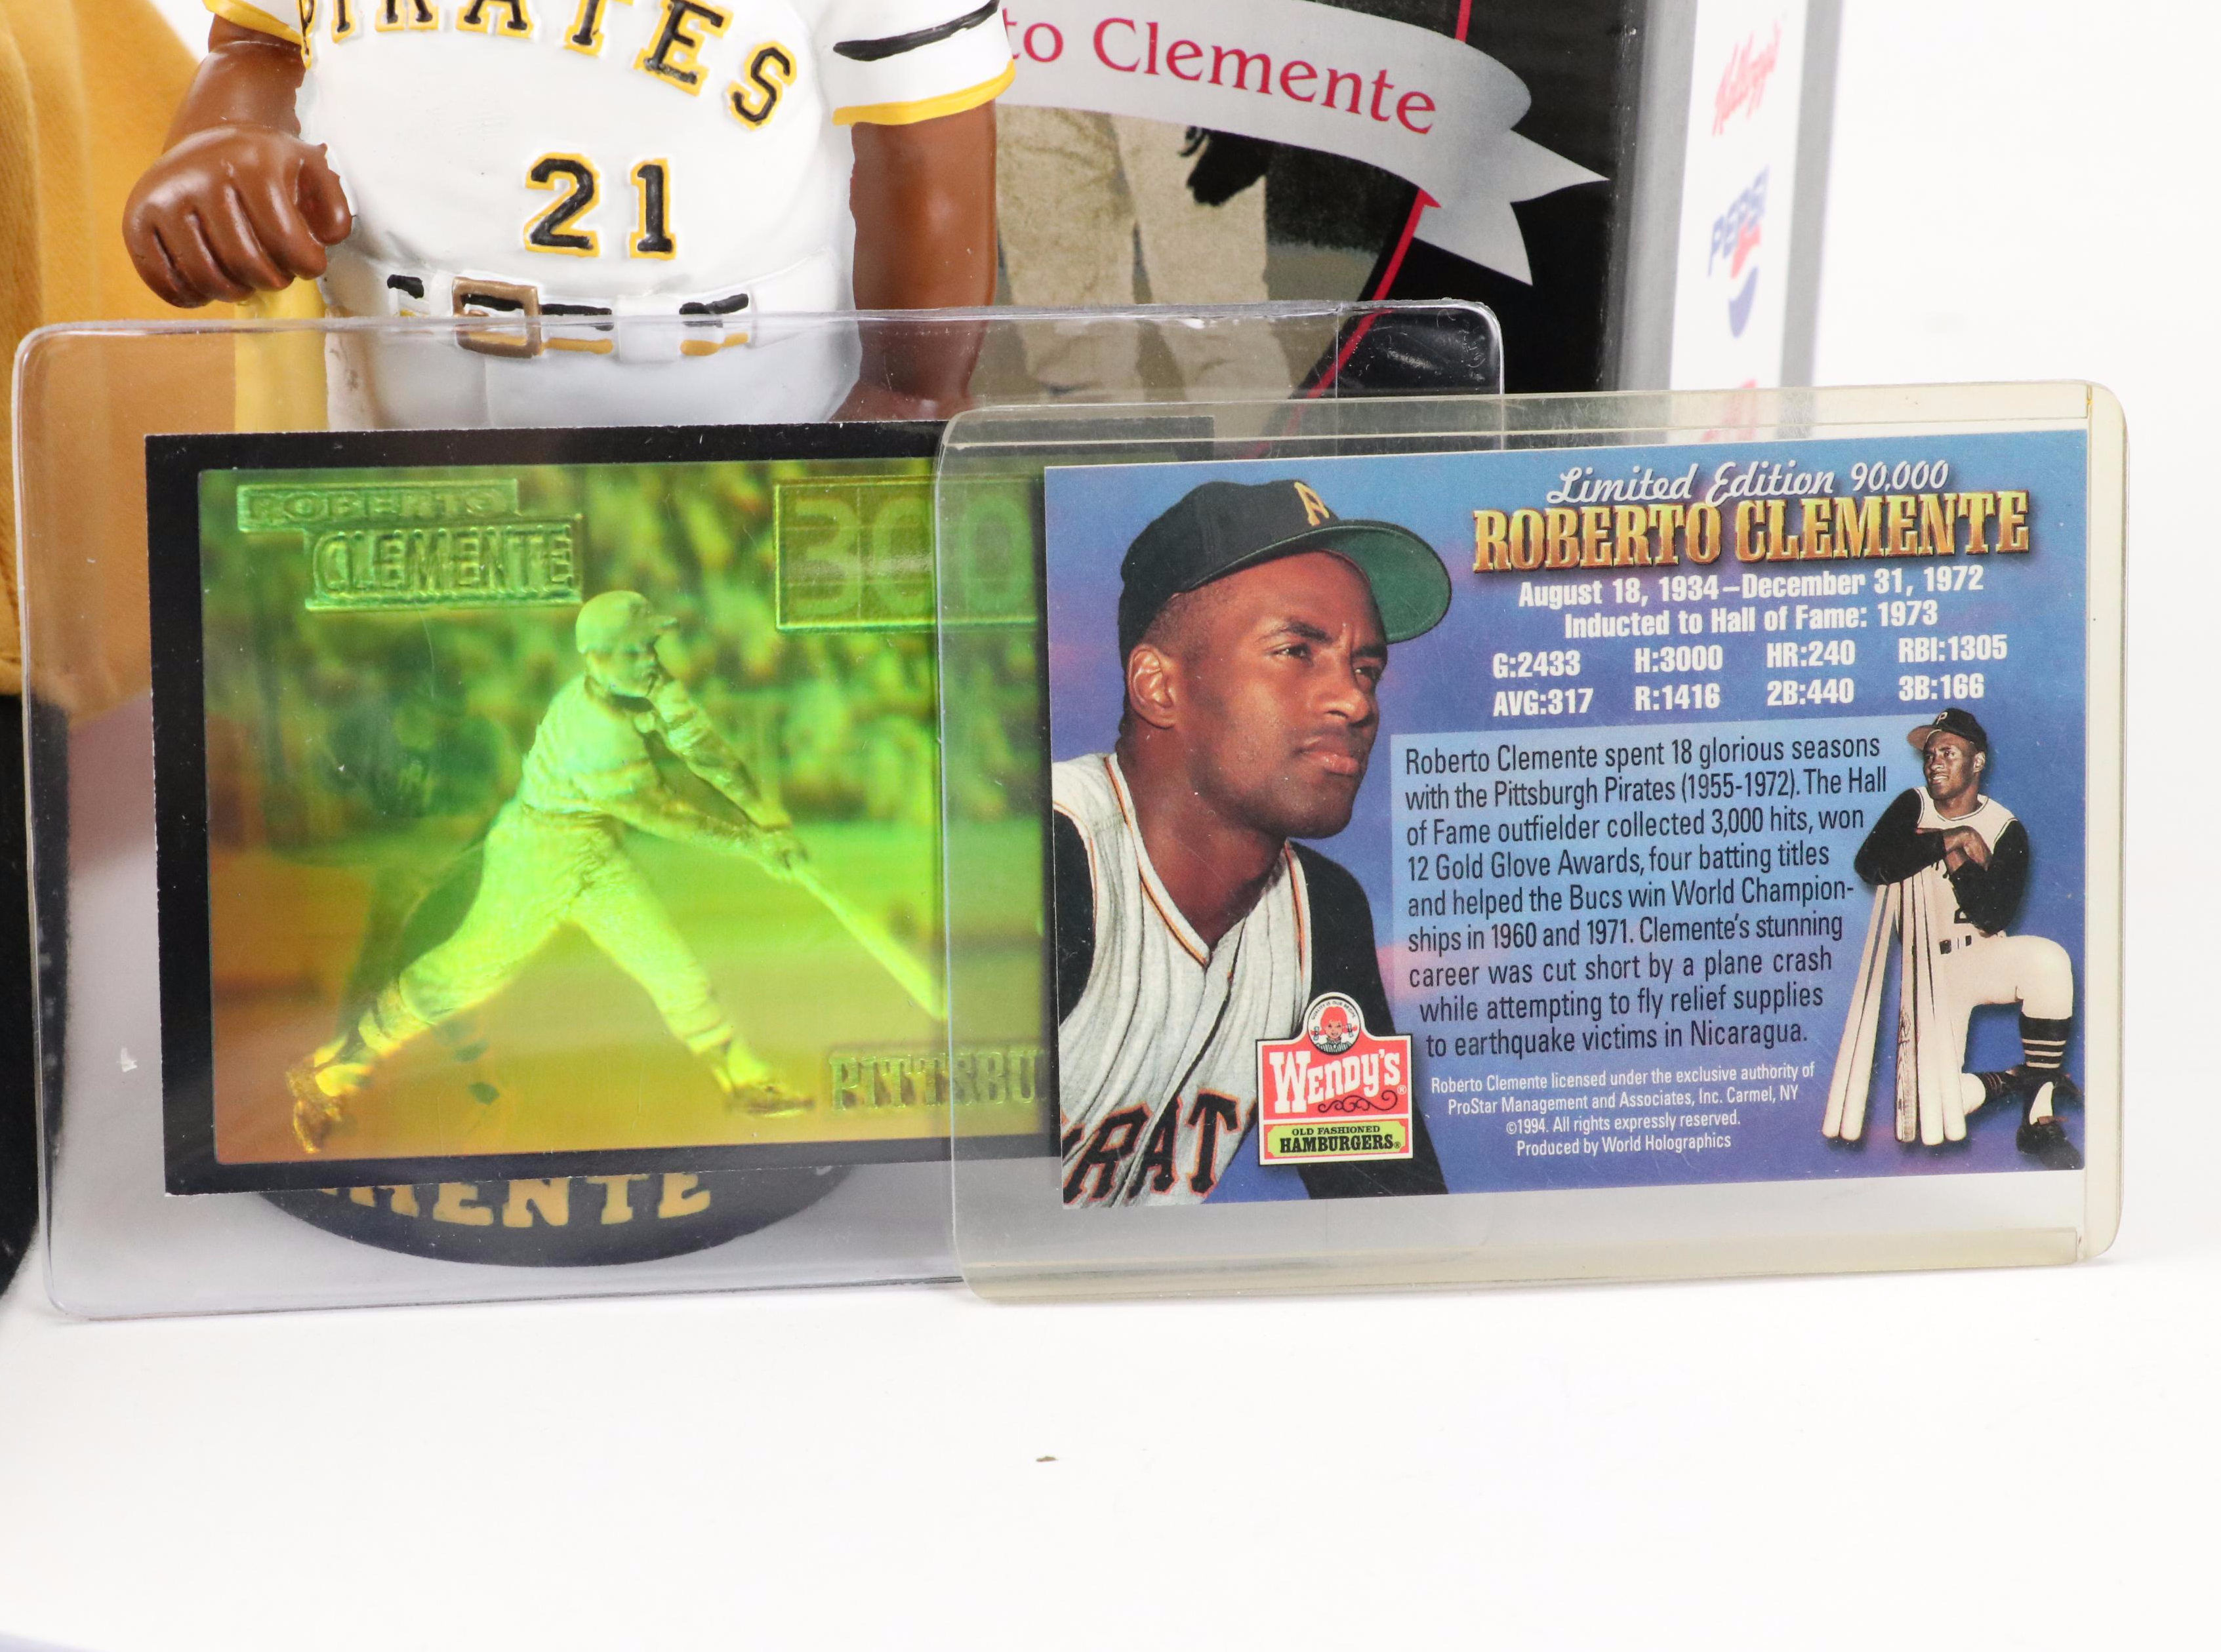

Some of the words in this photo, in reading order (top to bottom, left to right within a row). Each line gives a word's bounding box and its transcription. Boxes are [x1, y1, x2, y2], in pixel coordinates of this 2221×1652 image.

[1092, 18, 1437, 134] Clemente
[523, 151, 677, 260] 21
[1546, 464, 1700, 504] Limited
[1704, 461, 1836, 508] Edition
[1850, 459, 1950, 493] 90,000
[1473, 500, 1723, 573] ROBERTO
[1734, 489, 2031, 564] CLEMENTE
[313, 527, 575, 593] CLEMENTE
[1518, 580, 1604, 611] August
[1612, 577, 1649, 608] 18,
[1873, 567, 1914, 597] 31,
[1923, 564, 1984, 593] 1972
[1564, 609, 1670, 639] Inducted
[1677, 610, 1703, 634] to
[1711, 606, 1756, 634] Hall
[1764, 605, 1788, 632] of
[1795, 604, 1867, 630] Fame:
[1877, 599, 1938, 627] 1973
[1492, 649, 1581, 679] G:2433
[1635, 644, 1723, 674] H:3000
[1766, 639, 1856, 668] HR:240
[1898, 634, 2008, 663] RBI:1305
[1493, 687, 1594, 717] AVG:317
[1635, 683, 1721, 711] R:1416
[1766, 677, 1854, 706] 2B:440
[1898, 672, 1984, 701] 3B:166
[1406, 747, 1490, 775] Roberto
[1498, 744, 1597, 772] Clemente
[1605, 742, 1665, 773] spent
[1671, 738, 1692, 765] 18
[1699, 735, 1784, 770] glorious
[1792, 738, 1880, 760] seasons
[1405, 783, 1449, 811] with
[1454, 782, 1487, 809] the
[1495, 777, 1598, 811] Pittsburgh
[1605, 776, 1675, 803] Pirates
[1681, 768, 1800, 803] (1955-1972).
[1803, 768, 1842, 795] The
[1848, 765, 1886, 794] Hall
[1407, 819, 1427, 847] of
[1434, 818, 1490, 845] Fame
[1498, 813, 1600, 843] outfielder
[1607, 808, 1704, 838] collected
[1711, 807, 1763, 838] 3,000
[1770, 805, 1814, 834] hits,
[1818, 809, 1864, 830] won
[1408, 856, 1429, 881] 12
[1436, 852, 1483, 881] Gold
[1491, 851, 1551, 879] Glove
[1557, 847, 1644, 876] Awards,
[1648, 845, 1692, 872] four
[1700, 843, 1771, 874] batting
[1777, 839, 1829, 867] titles
[1408, 889, 1446, 917] and
[1453, 886, 1523, 920] helped
[1528, 885, 1562, 912] the
[1570, 884, 1622, 910] Bucs
[1628, 881, 1665, 908] win
[1671, 877, 1734, 906] World
[1742, 874, 1854, 908] Champion-
[1408, 925, 1461, 957] ships
[1467, 923, 1484, 950] in
[1491, 921, 1537, 949] 1960
[1543, 919, 1579, 947] and
[1587, 918, 1634, 945] 1971.
[1640, 913, 1750, 943] Clemente's
[1756, 915, 1843, 942] stunning
[1409, 966, 1480, 988] career
[1488, 964, 1533, 984] was
[1543, 958, 1577, 982] cut
[1585, 954, 1640, 980] short
[1649, 952, 1674, 984] by
[1682, 957, 1694, 977] a
[1705, 949, 1763, 982] plane
[1773, 944, 1831, 973] crash
[1419, 994, 1478, 1023] while
[1487, 990, 1602, 1024] attempting
[1608, 992, 1630, 1015] to
[1637, 987, 1663, 1019] fly
[1671, 984, 1726, 1012] relief
[1734, 980, 1823, 1015] supplies
[1425, 1034, 1446, 1058] to
[1455, 1026, 1575, 1060] earthquake
[1582, 1023, 1657, 1051] victims
[1665, 1021, 1682, 1047] in
[1691, 1019, 1807, 1050] Nicaragua.
[1431, 1076, 1483, 1094] Roberto
[1486, 1074, 1548, 1091] Clemente
[1551, 1070, 1606, 1089] licensed
[1610, 1068, 1648, 1086] under
[1650, 1068, 1672, 1084] the
[1676, 1066, 1737, 1083] exclusive
[1741, 1063, 1799, 1082] authority
[1801, 1061, 1816, 1078] of
[1448, 1097, 1498, 1116] ProStar
[1501, 1095, 1589, 1115] Management
[1591, 1091, 1616, 1109] and
[1619, 1091, 1695, 1108] Associates,
[1699, 1087, 1722, 1104] Inc.
[1726, 1085, 1776, 1104] Carmel,
[1780, 1084, 1799, 1101] NY
[1553, 1116, 1570, 1133] All
[1574, 1115, 1610, 1135] rights
[1614, 1112, 1677, 1133] expressly
[1680, 1108, 1742, 1127] reserved.
[1318, 1125, 1380, 1135] FASHIONED
[1517, 1138, 1579, 1156] Produced
[1583, 1137, 1599, 1157] by
[1601, 1135, 1641, 1153] World
[1645, 1131, 1732, 1154] Holographics
